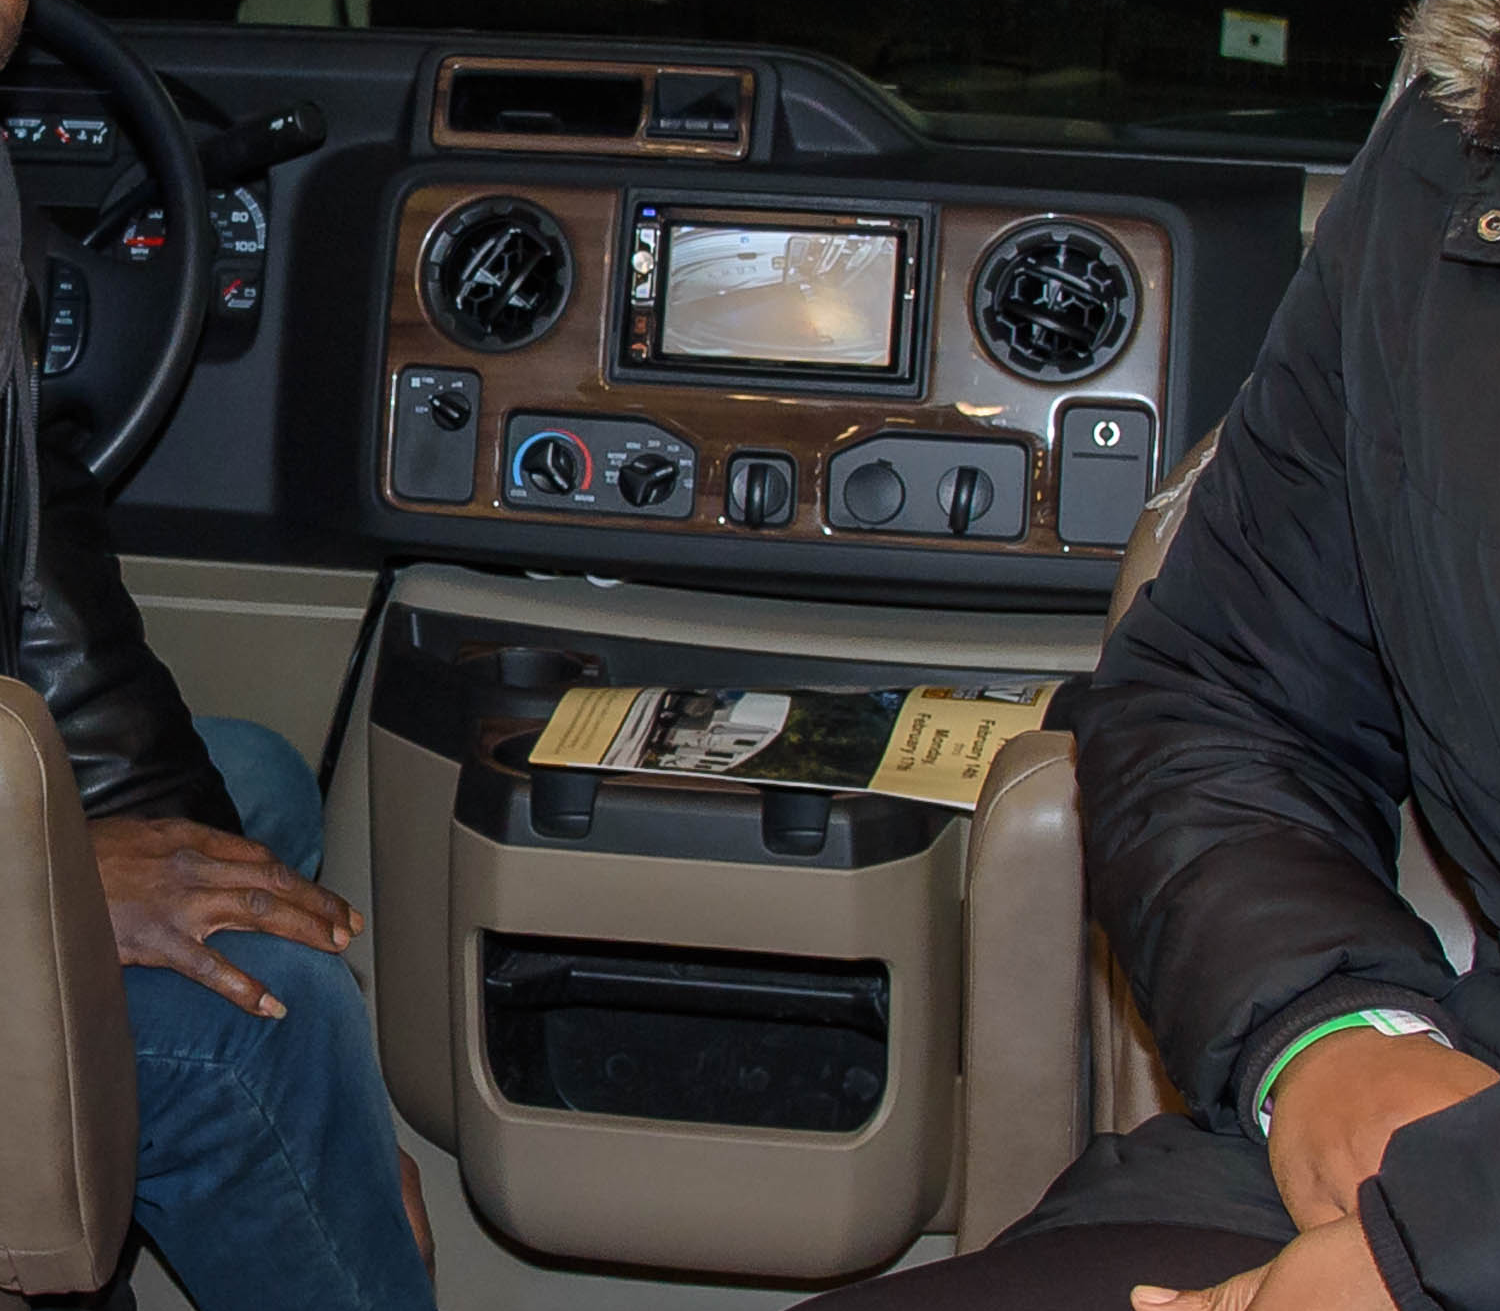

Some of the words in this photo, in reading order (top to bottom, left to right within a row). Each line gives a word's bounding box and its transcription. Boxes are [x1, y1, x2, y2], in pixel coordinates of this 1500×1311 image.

[235, 240, 257, 253] 100
[901, 713, 931, 754] February
[966, 719, 996, 760] February
